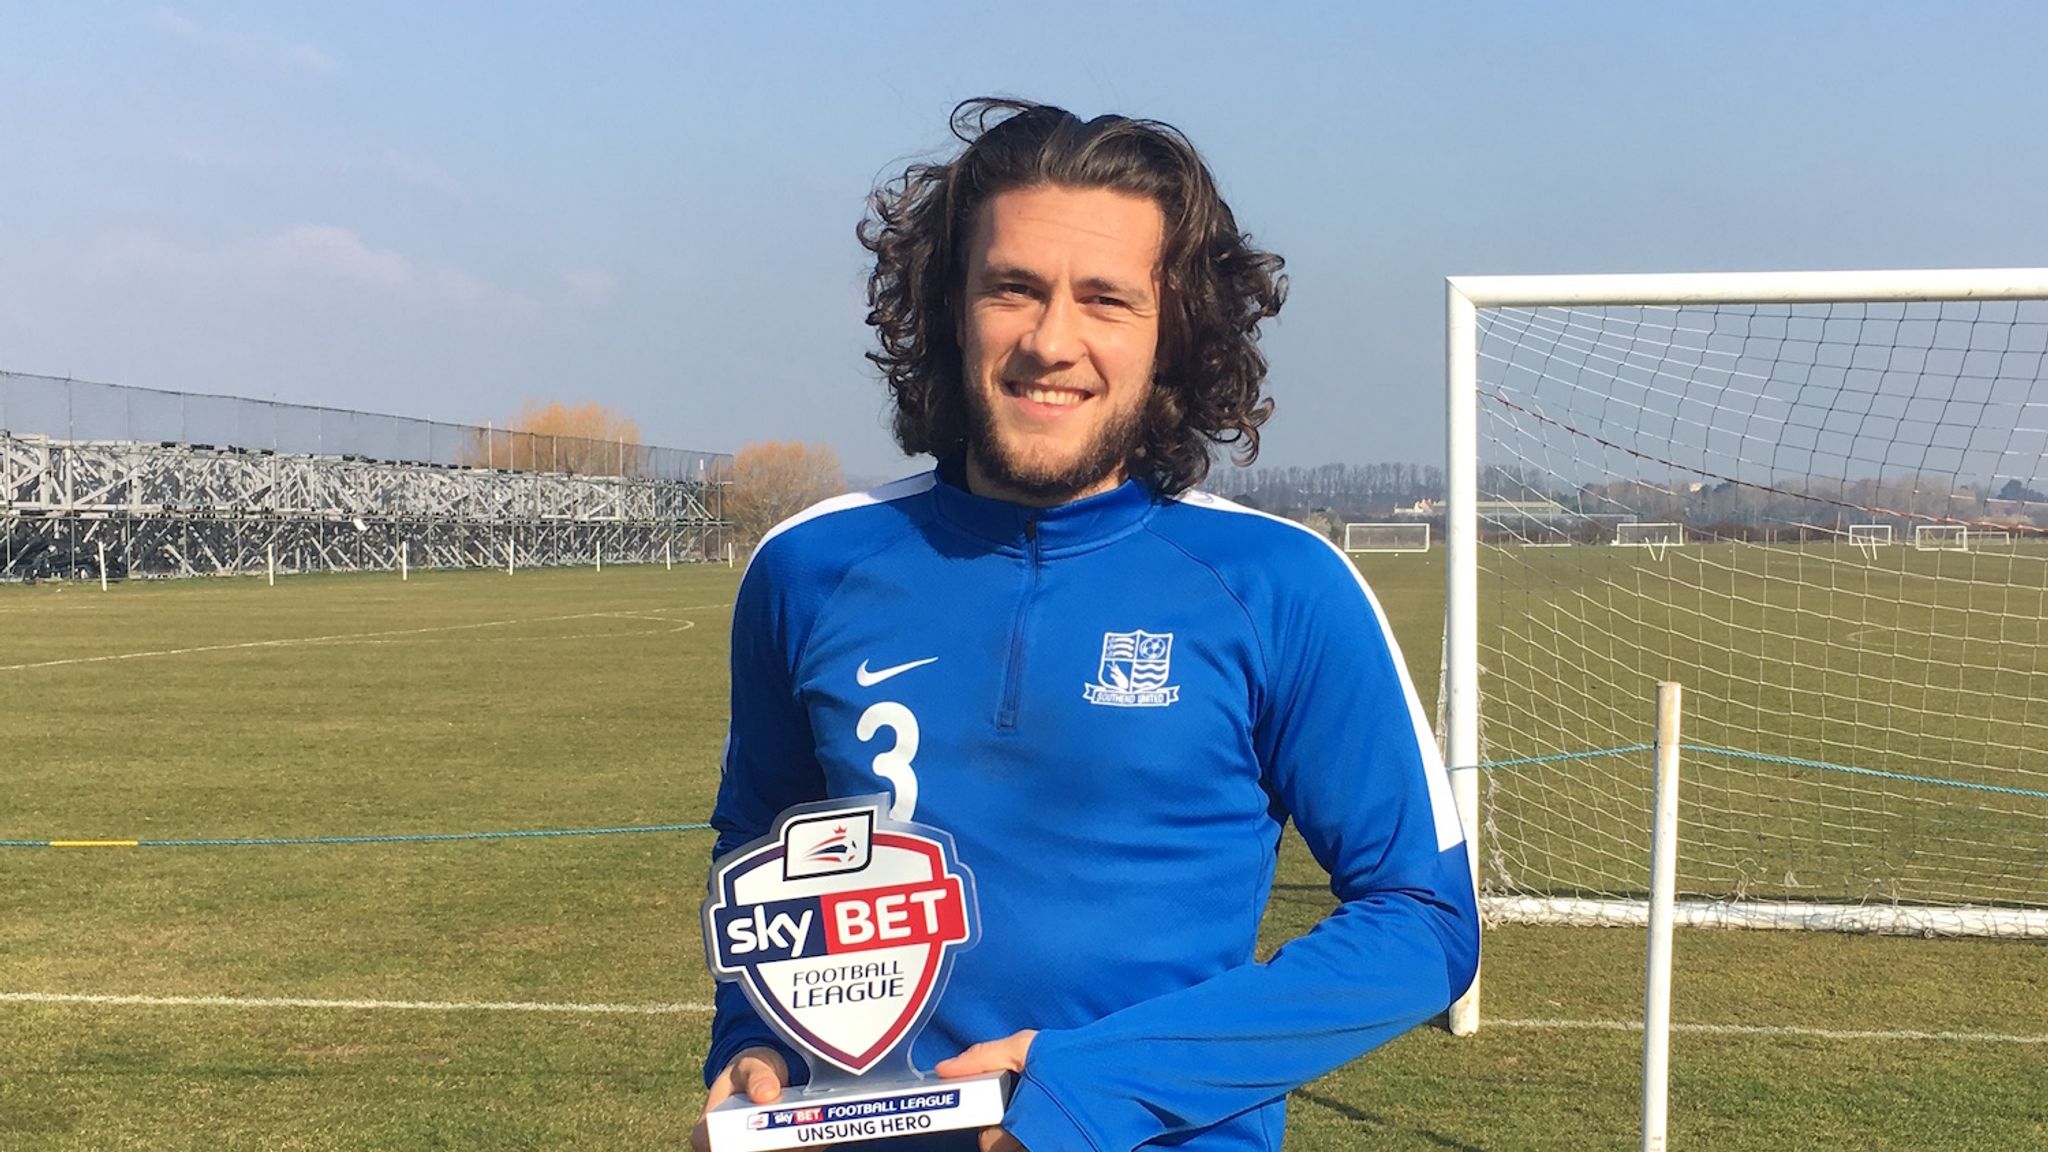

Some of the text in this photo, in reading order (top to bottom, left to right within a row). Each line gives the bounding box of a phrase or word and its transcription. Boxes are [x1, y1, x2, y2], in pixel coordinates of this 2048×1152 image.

[1138, 693, 1164, 703] UNITED
[856, 701, 919, 823] 3
[727, 889, 947, 957] sky BET
[793, 960, 904, 987] FOOTBALL
[792, 978, 904, 1009] LEAGUE
[774, 1093, 954, 1124] sky BET FOOTBALL LEAGUE
[797, 1114, 931, 1143] UNSUNG HERO
